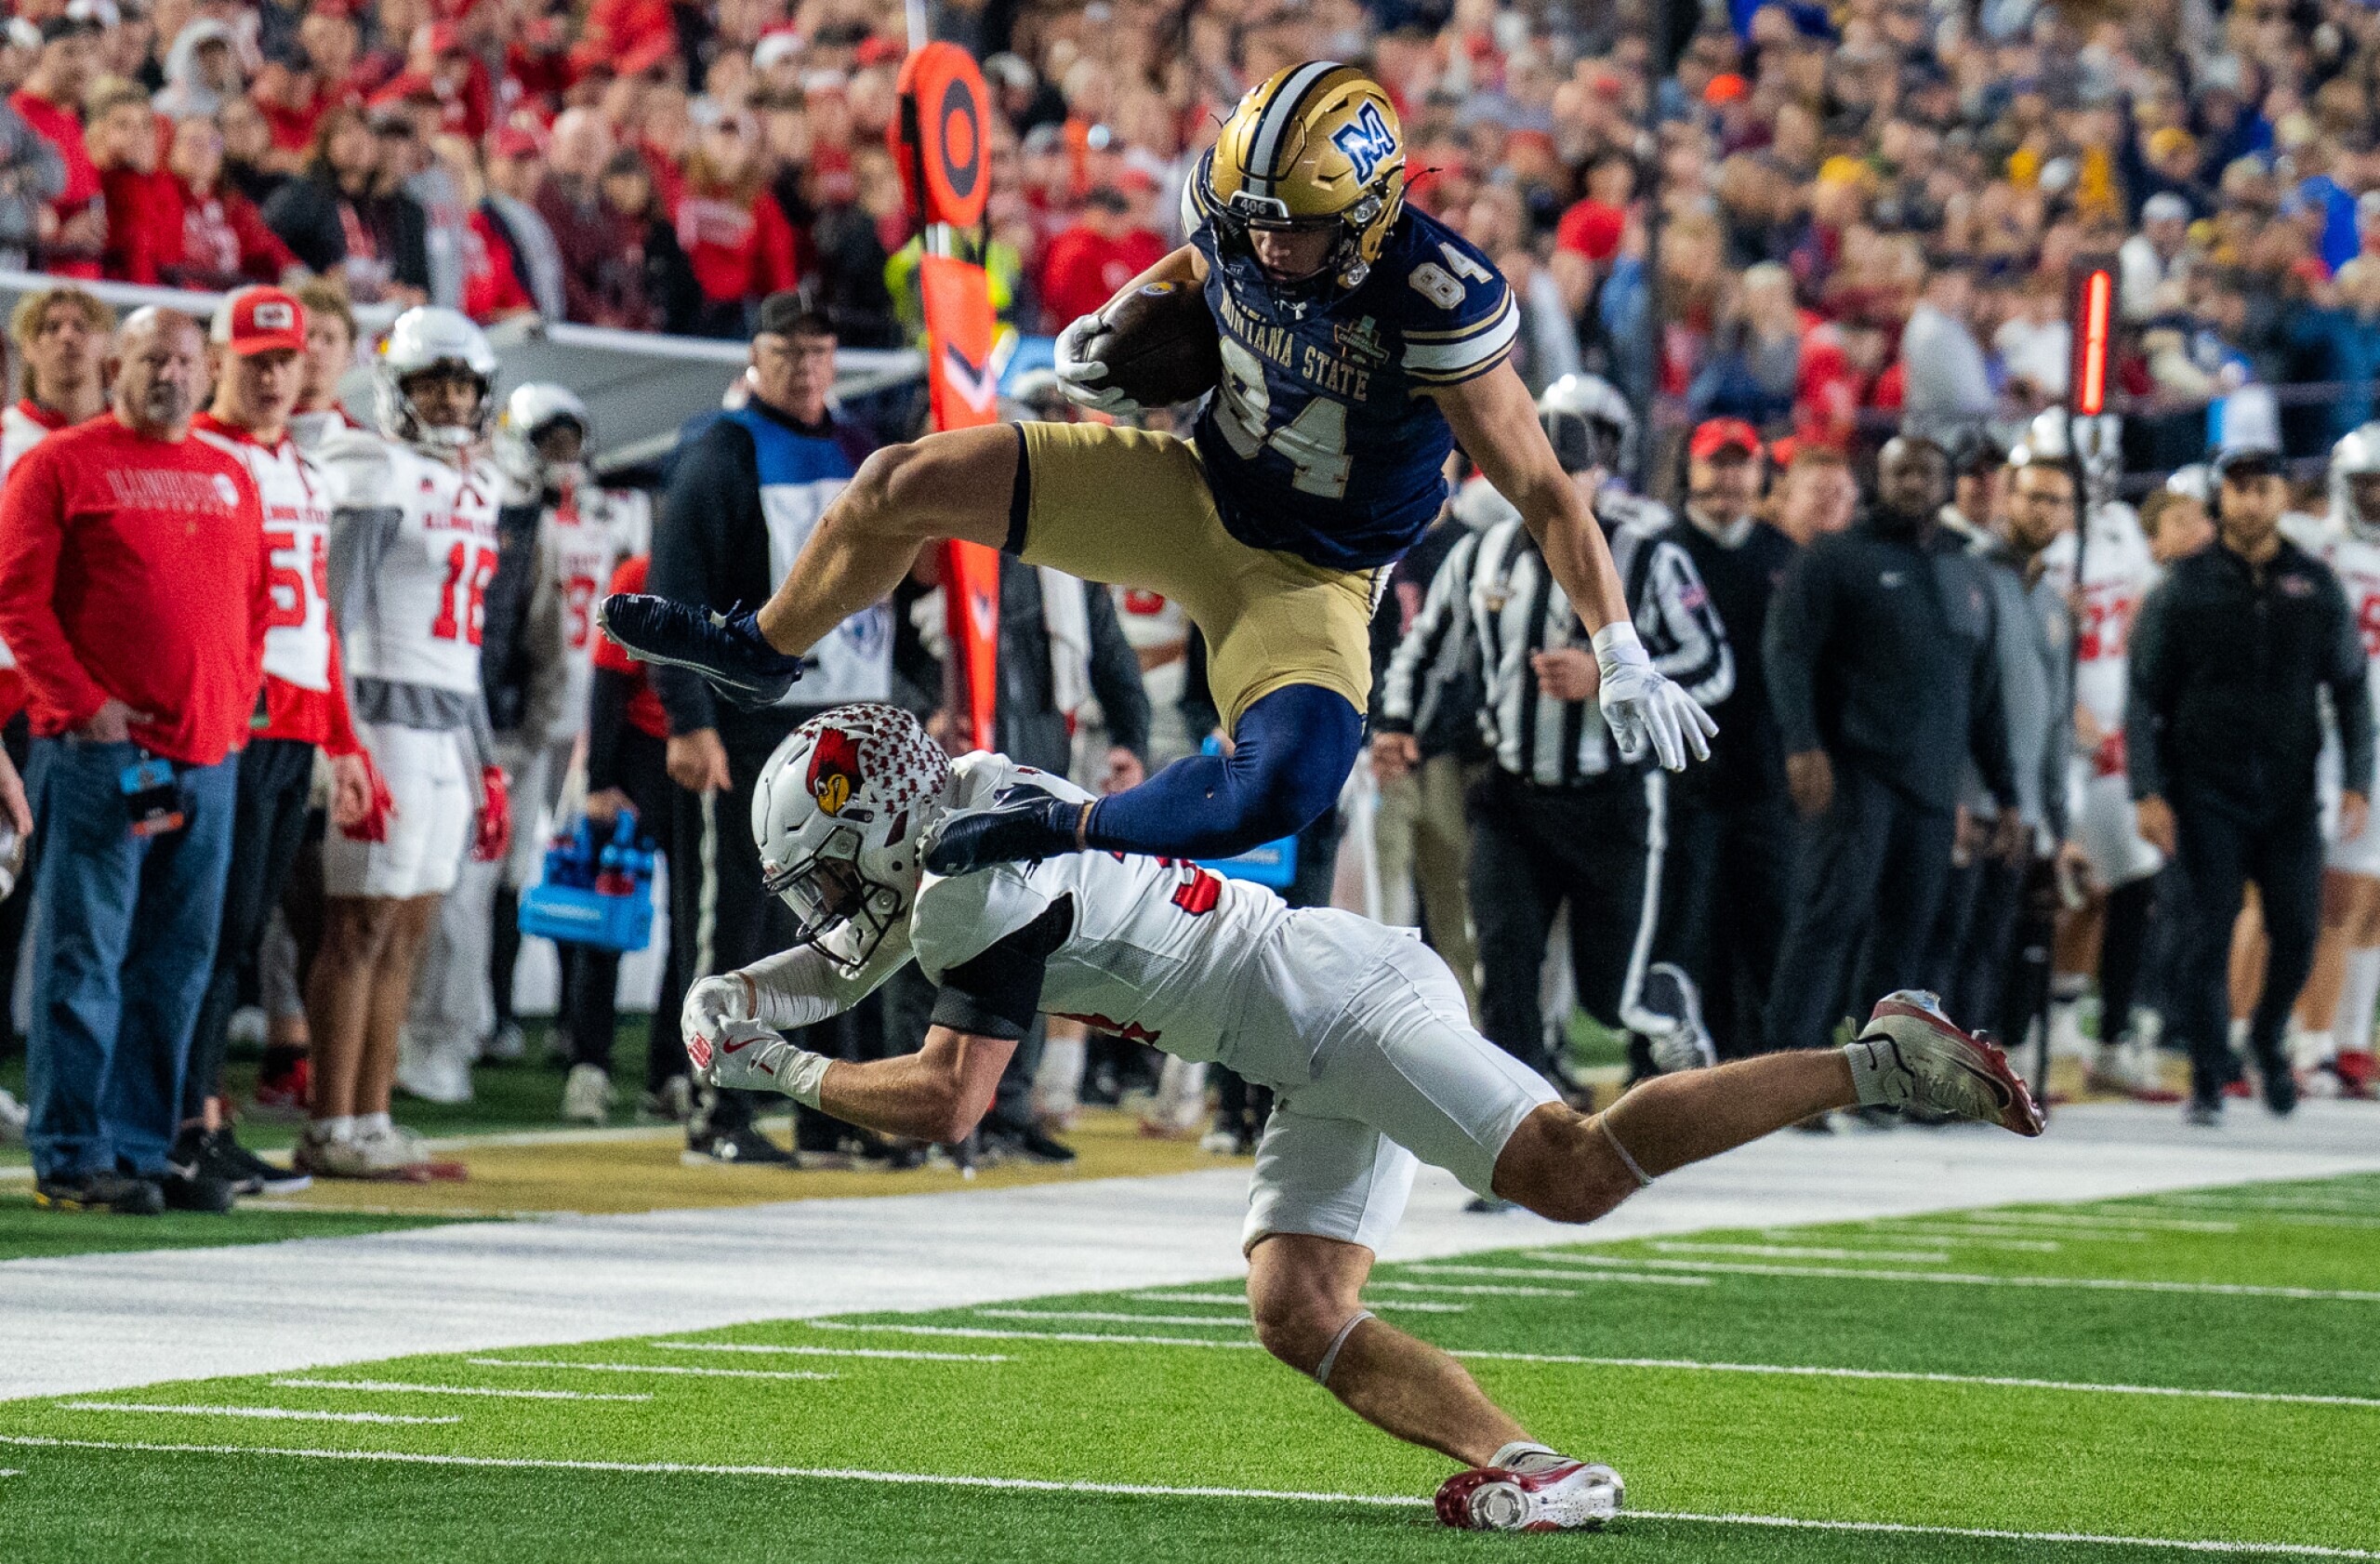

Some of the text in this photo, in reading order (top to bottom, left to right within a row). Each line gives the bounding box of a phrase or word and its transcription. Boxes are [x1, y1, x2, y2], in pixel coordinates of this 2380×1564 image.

[1330, 100, 1395, 186] M
[1240, 198, 1266, 215] 406
[1408, 242, 1493, 310] 84
[1220, 283, 1293, 368] MONTANA
[1302, 345, 1370, 401] STATE
[1213, 334, 1353, 499] 84
